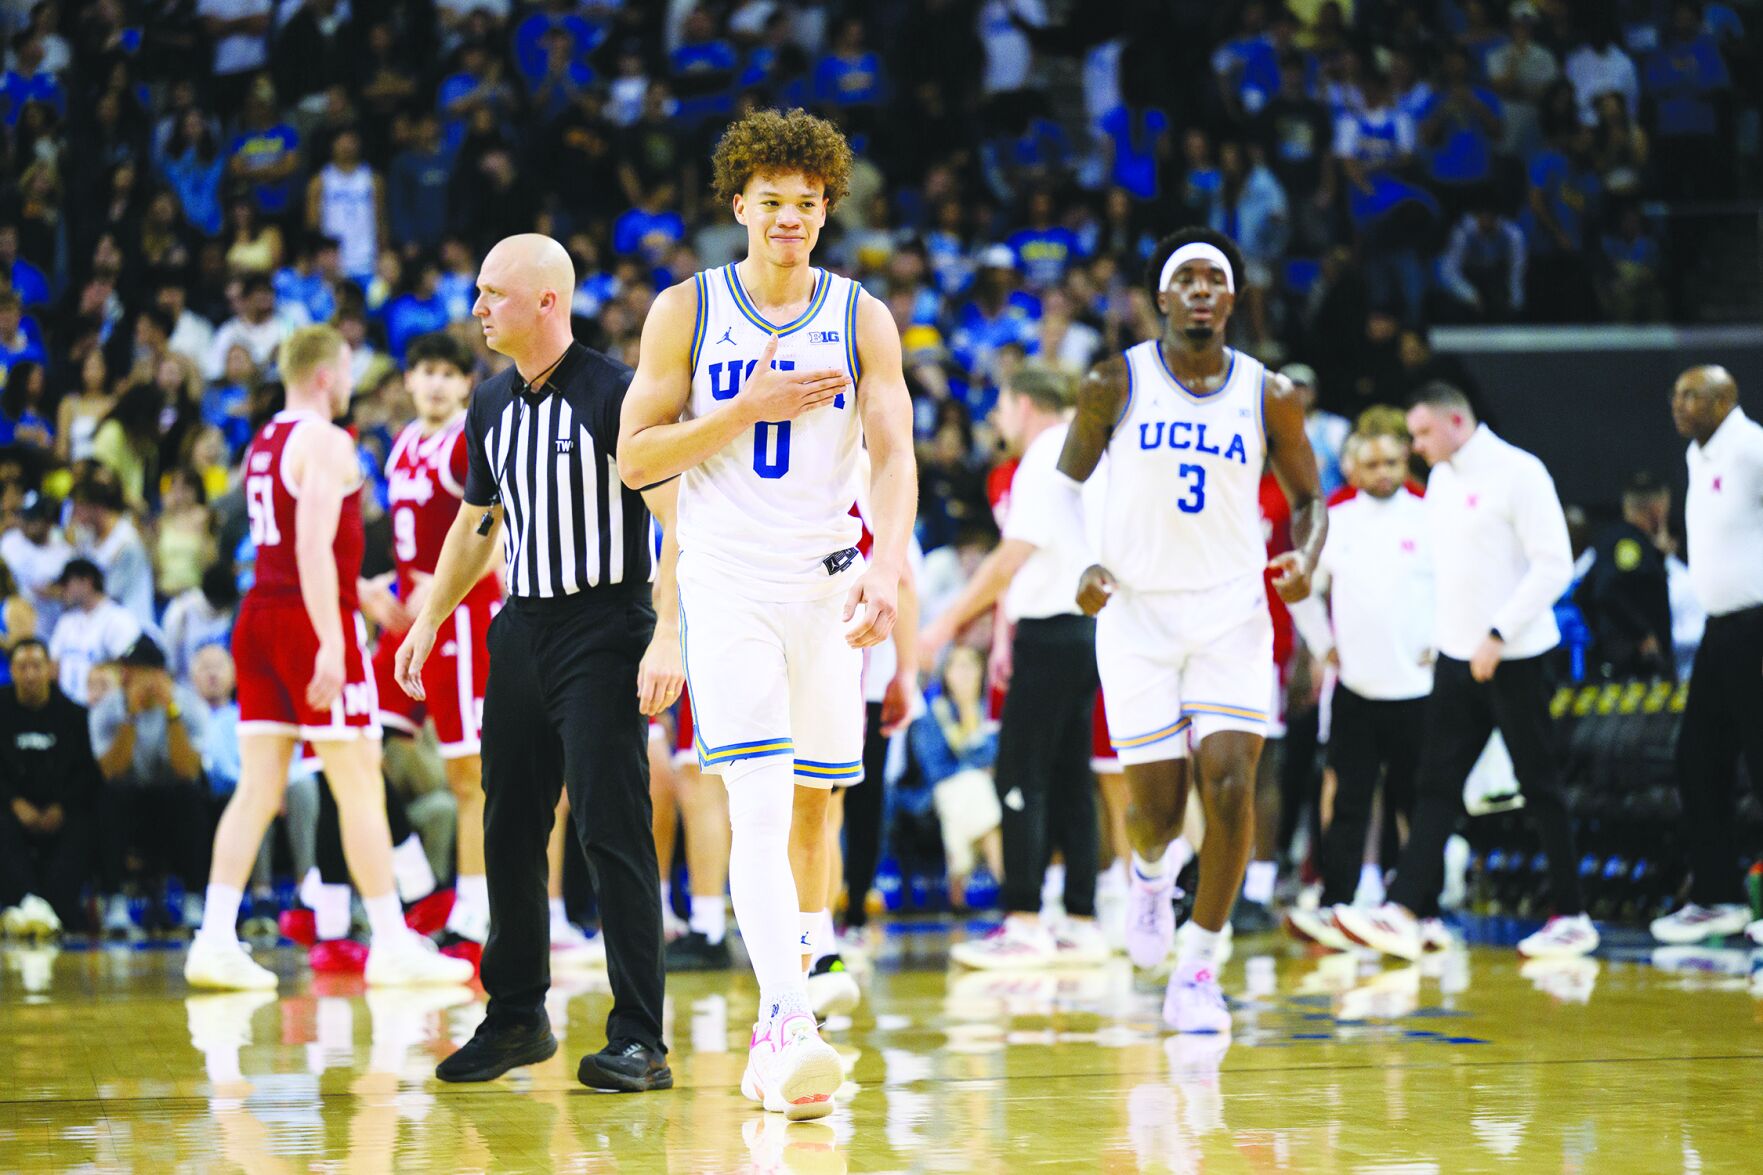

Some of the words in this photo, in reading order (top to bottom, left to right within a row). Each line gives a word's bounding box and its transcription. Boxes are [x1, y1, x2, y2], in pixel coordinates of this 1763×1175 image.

[753, 420, 791, 479] 0
[1139, 422, 1247, 464] UCLA
[246, 474, 281, 546] 51
[1177, 463, 1206, 514] 3
[394, 507, 417, 562] 9
